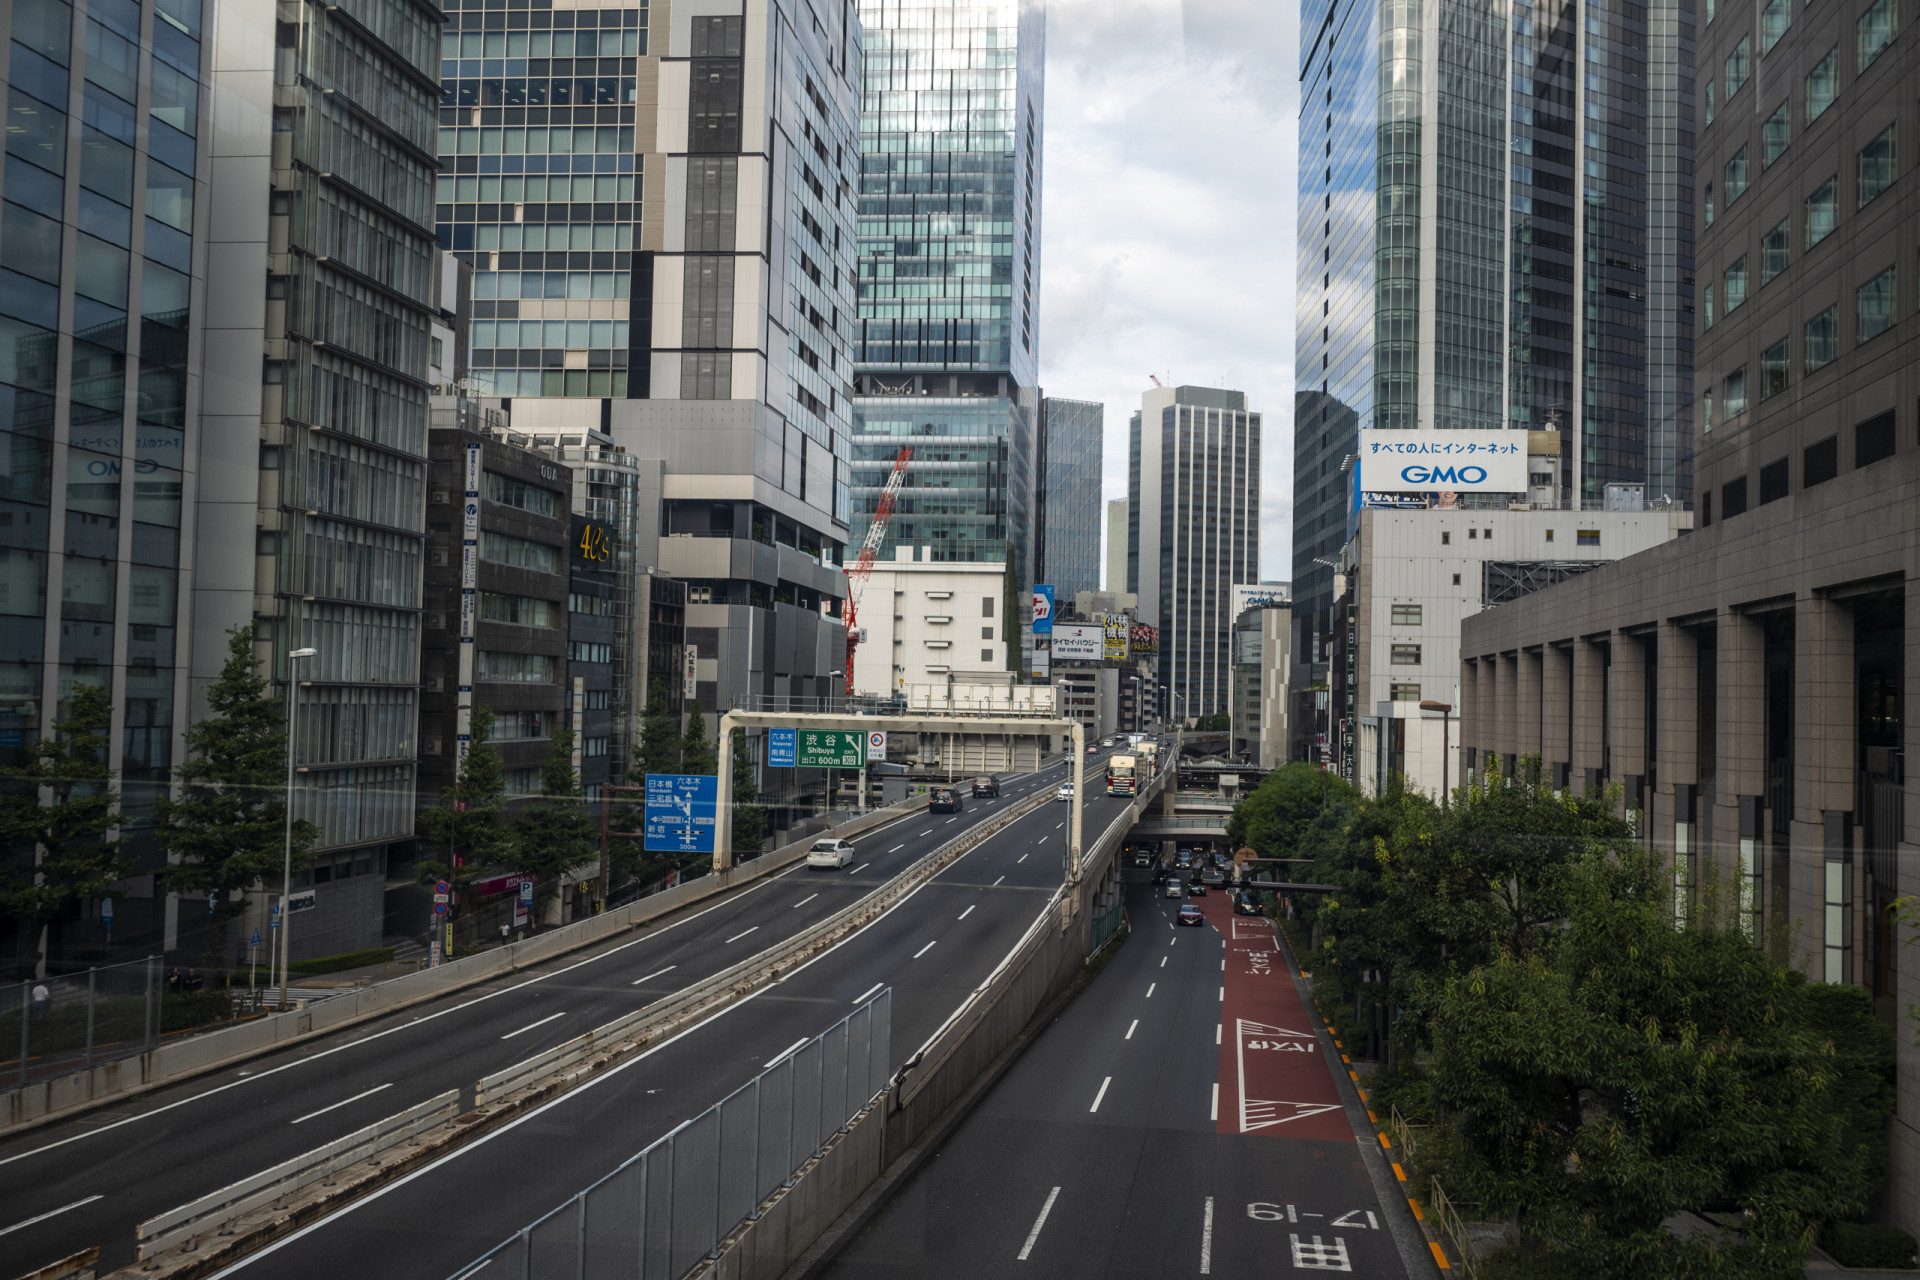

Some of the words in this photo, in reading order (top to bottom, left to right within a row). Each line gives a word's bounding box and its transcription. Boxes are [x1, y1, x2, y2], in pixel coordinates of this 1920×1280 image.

[1370, 442, 1518, 454] すべての人にインターネット
[1401, 465, 1487, 484] GMO
[806, 734, 836, 747] 渋谷
[771, 749, 793, 757] 南青山
[807, 747, 835, 755] Shibuya
[801, 756, 816, 764] 出口
[818, 757, 840, 765] 600m
[844, 756, 855, 764] 302
[648, 779, 673, 788] 日本橋
[677, 777, 701, 785] 六本木
[648, 794, 672, 802] 三宅坂
[647, 825, 665, 833] 新宿
